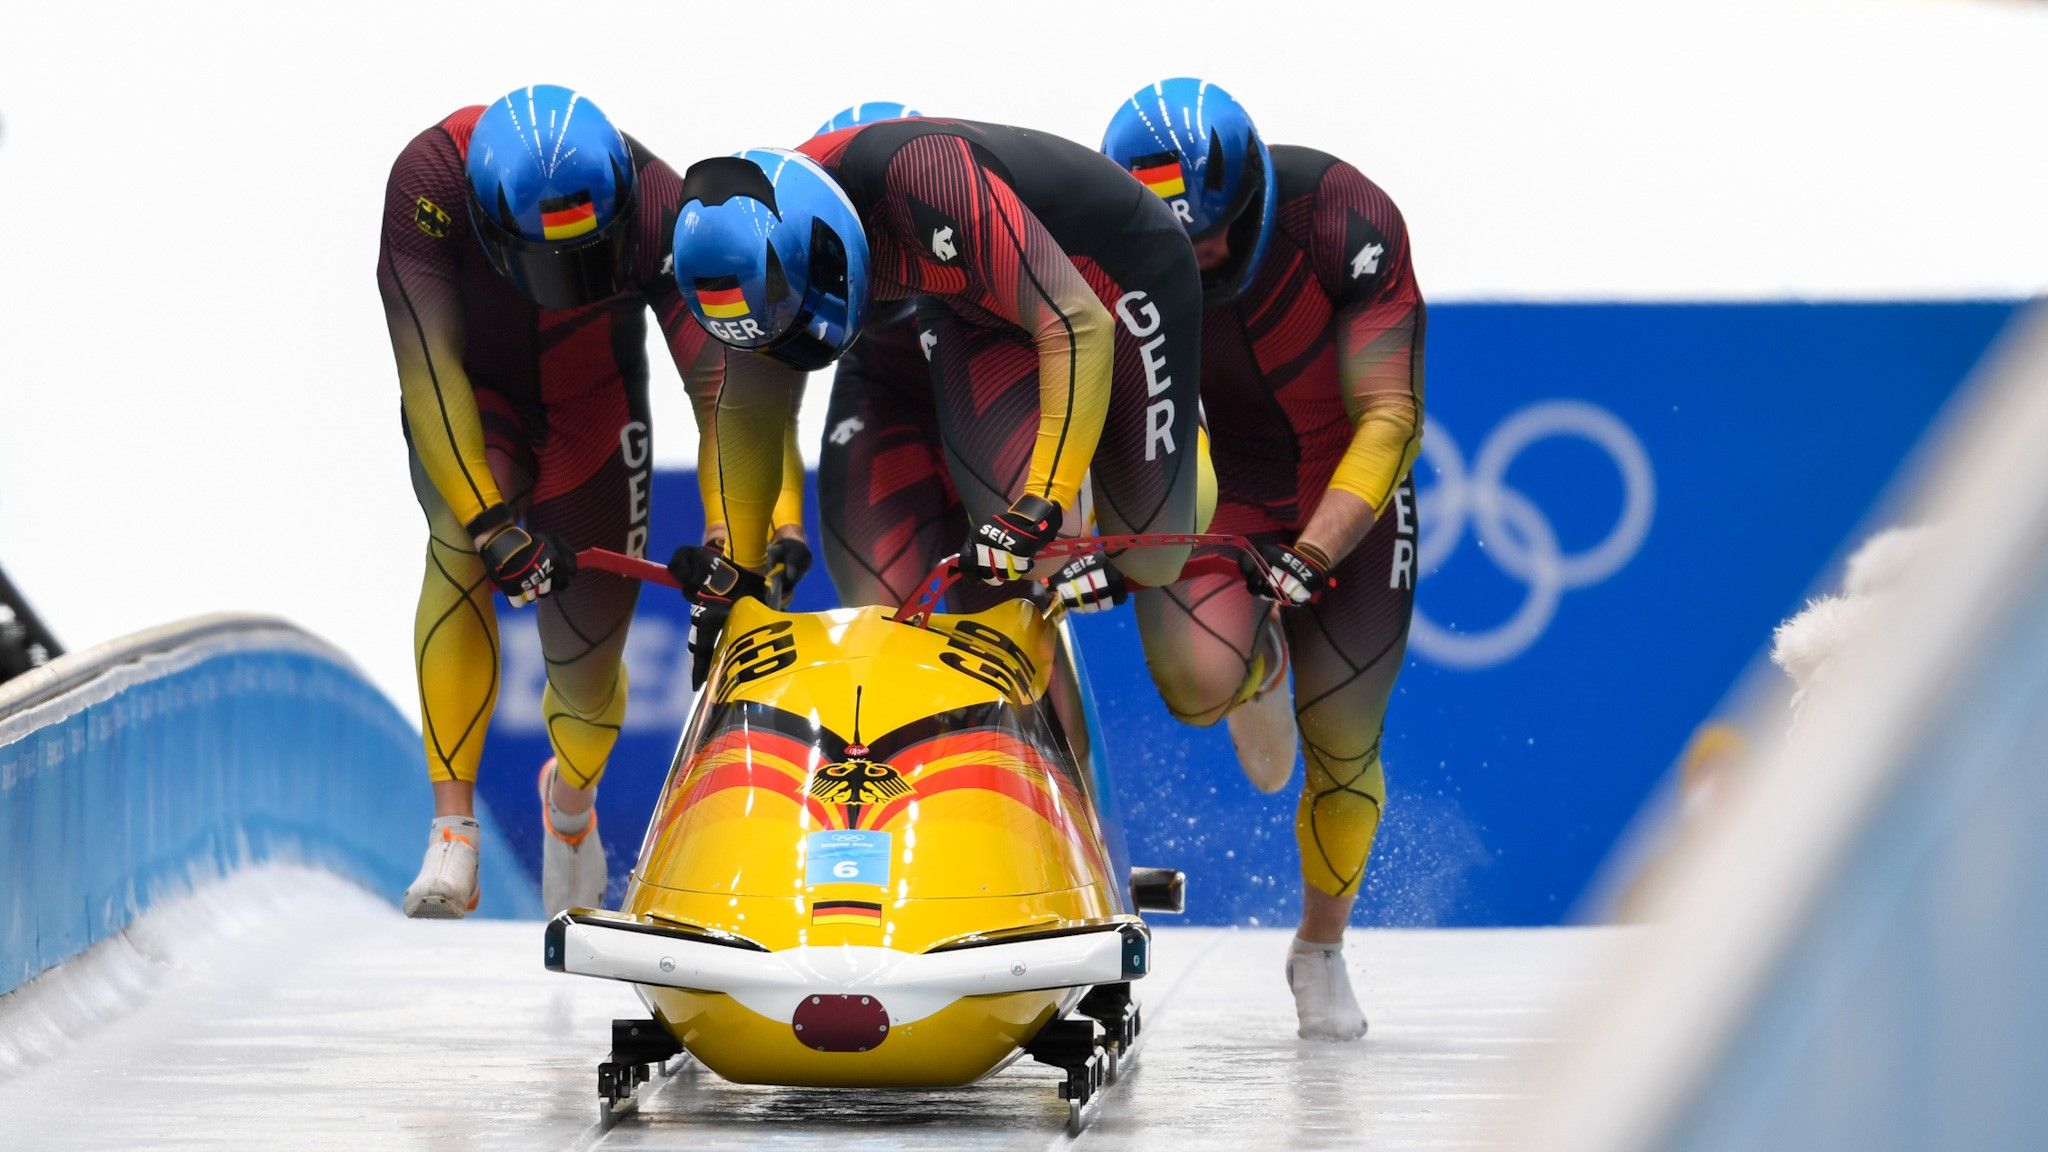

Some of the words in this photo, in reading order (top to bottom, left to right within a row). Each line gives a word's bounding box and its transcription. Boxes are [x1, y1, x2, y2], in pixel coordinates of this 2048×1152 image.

[709, 318, 766, 341] GER
[1115, 290, 1176, 462] GER
[979, 524, 1017, 551] SEIZ
[1389, 475, 1414, 590] ER
[520, 558, 555, 592] SEIZ
[1062, 555, 1097, 579] SEIZ
[1281, 551, 1313, 582] SEIZ
[832, 861, 860, 878] 6
